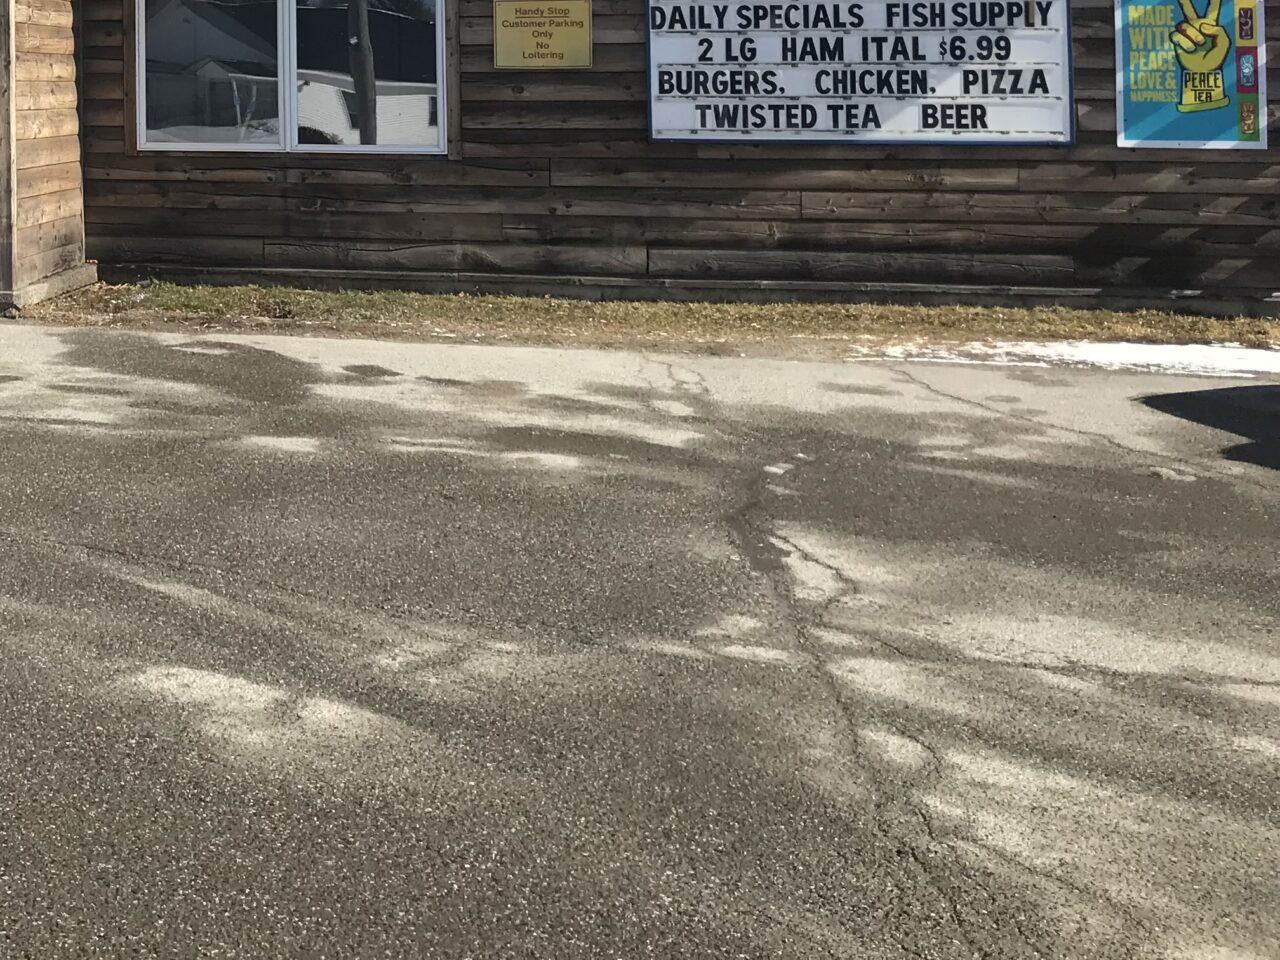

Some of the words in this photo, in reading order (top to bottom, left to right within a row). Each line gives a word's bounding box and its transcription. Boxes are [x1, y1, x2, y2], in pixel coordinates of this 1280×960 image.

[514, 7, 545, 16] Handy
[547, 7, 570, 16] Stop
[650, 5, 729, 30] DAILY
[736, 3, 864, 29] SPECIALS
[886, 2, 945, 28] FISH
[951, 0, 1053, 28] SUPPLY
[1128, 5, 1175, 25] MADE
[502, 20, 546, 28] Customer
[549, 19, 584, 28] Parking
[532, 30, 554, 39] Only
[536, 41, 550, 50] No
[698, 38, 713, 62] 2
[725, 37, 757, 62] LG
[782, 37, 844, 62] HAM
[861, 36, 926, 61] ITAL
[939, 35, 1011, 61] $6.99
[522, 51, 564, 60] Loitering
[1129, 51, 1176, 71] PEACE
[658, 70, 785, 95] BURGERS,
[815, 69, 936, 95] CHICKEN,
[962, 68, 1050, 94] PIZZA
[1130, 72, 1163, 89] LOVE
[1165, 72, 1177, 89] &
[1184, 72, 1221, 88] PEACE
[1130, 90, 1177, 102] HAPPINESS
[1192, 90, 1213, 102] TEA
[695, 104, 817, 129] TWISTED
[827, 104, 881, 129] TEA
[922, 103, 988, 129] BEER
